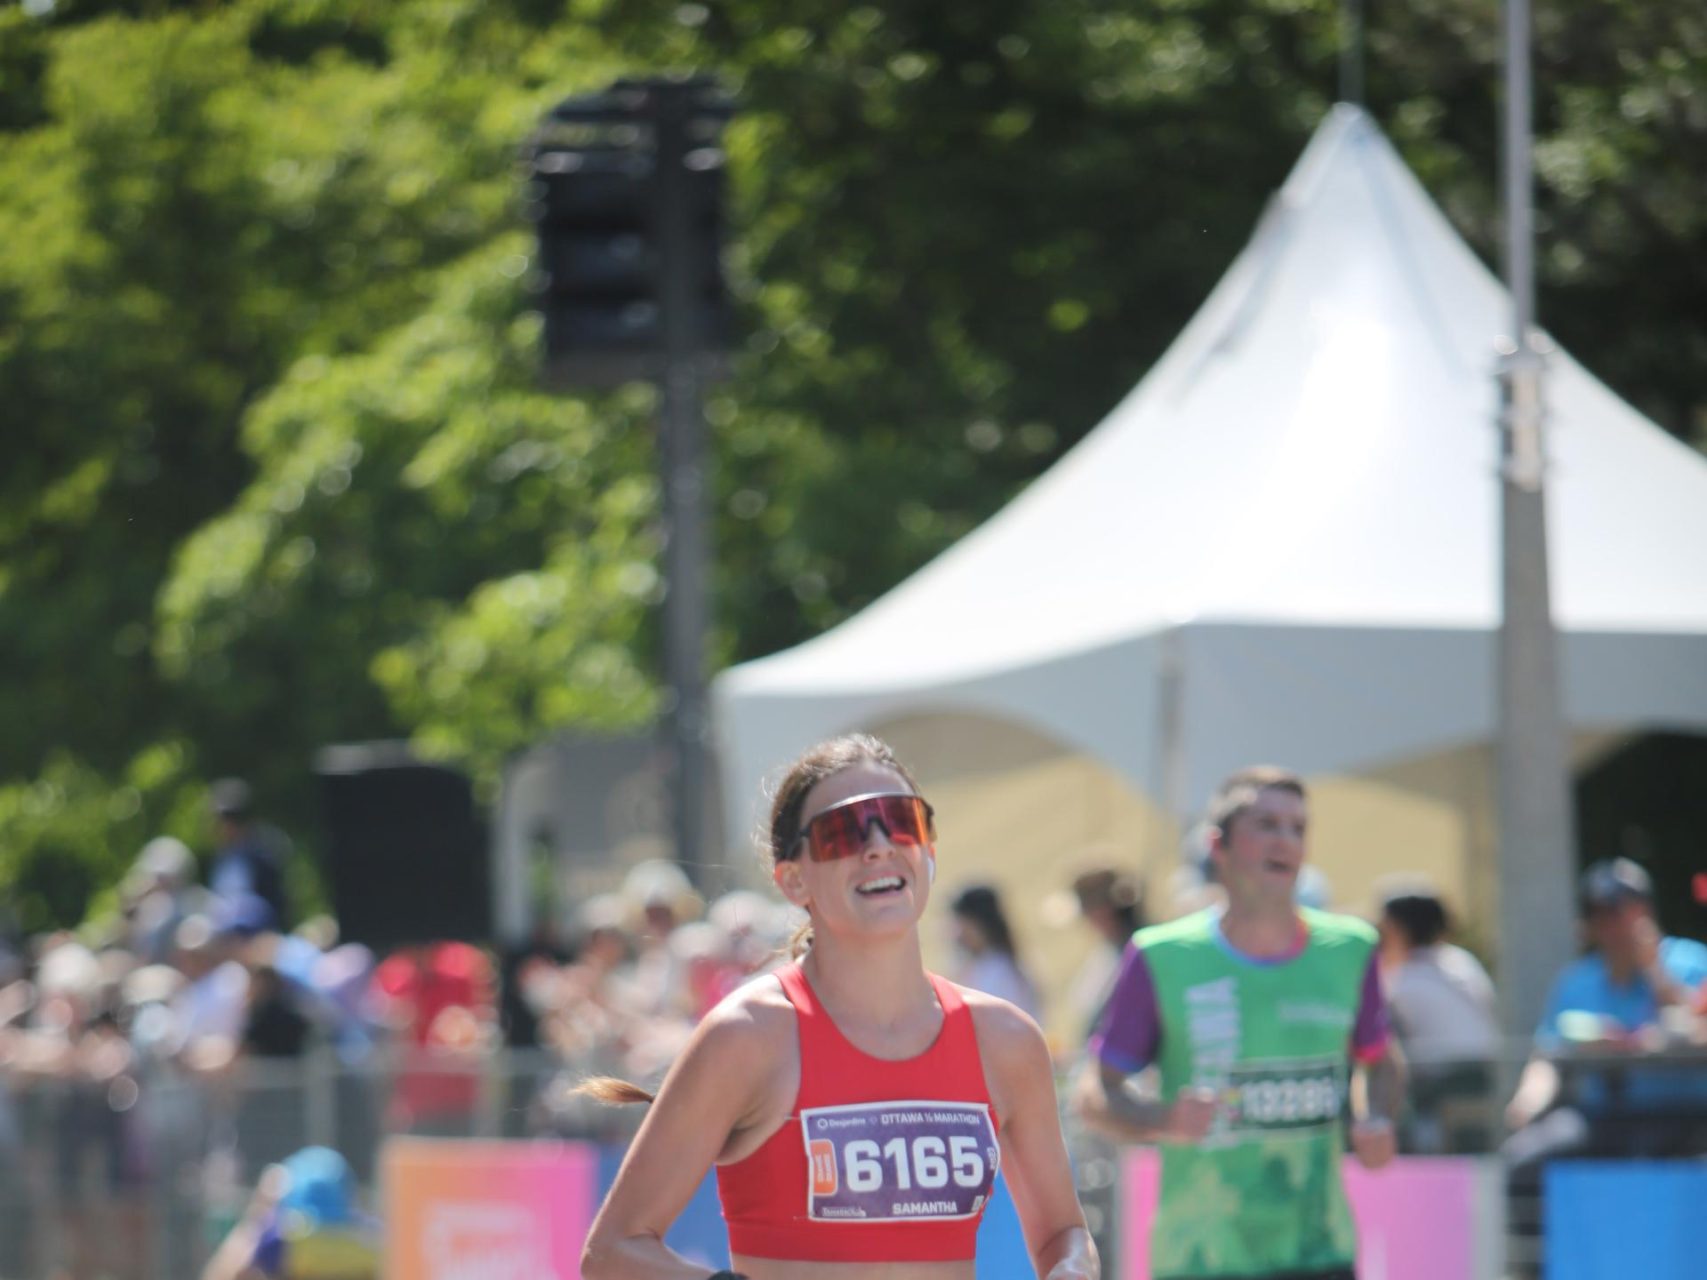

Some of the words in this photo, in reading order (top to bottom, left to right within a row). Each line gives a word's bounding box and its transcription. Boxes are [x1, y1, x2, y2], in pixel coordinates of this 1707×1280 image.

[881, 1112, 924, 1125] OTTAWA
[933, 1112, 980, 1124] MARATHON
[844, 1136, 984, 1192] 6165
[893, 1201, 957, 1215] SAMANTHA
